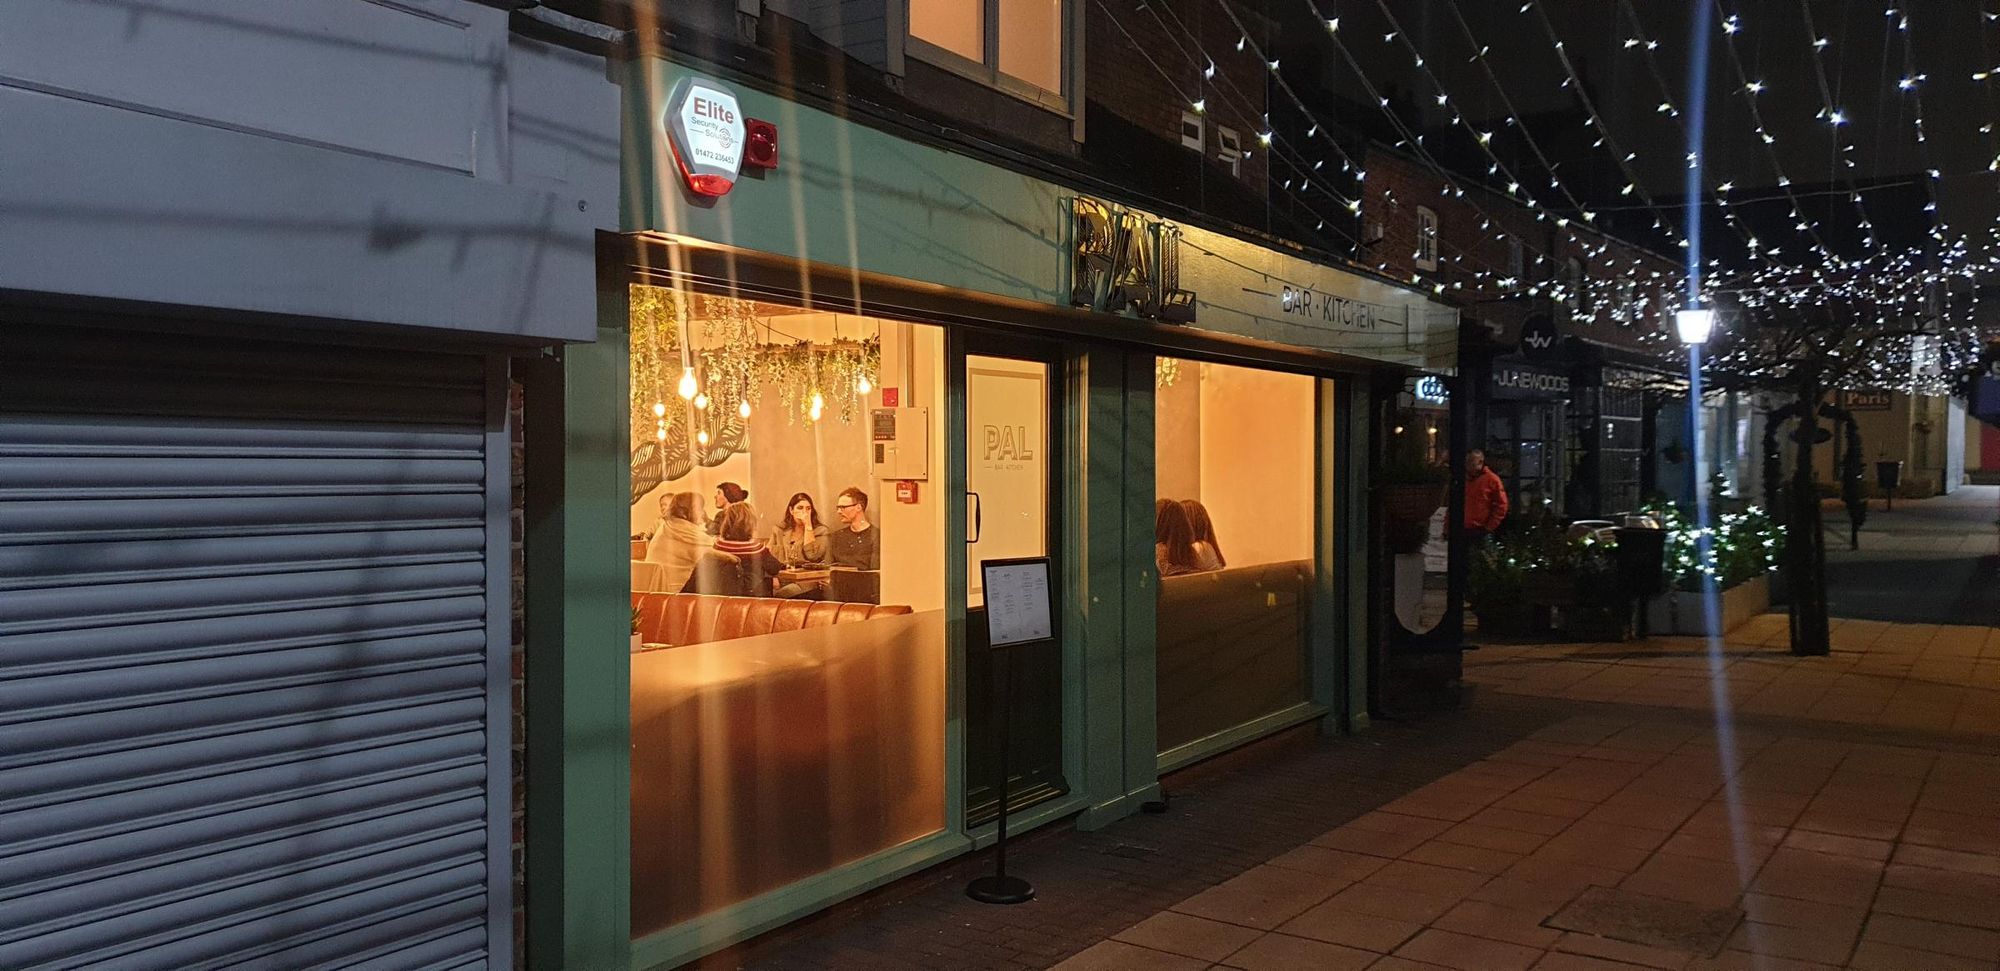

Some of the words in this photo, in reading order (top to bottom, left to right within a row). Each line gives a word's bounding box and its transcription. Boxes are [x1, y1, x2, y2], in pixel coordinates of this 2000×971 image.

[691, 116, 719, 130] Security
[694, 97, 733, 124] Elite
[695, 148, 714, 159] 01472
[1072, 194, 1197, 323] PAL
[1283, 285, 1312, 318] BAR
[1323, 295, 1375, 330] KITCHEN
[1847, 391, 1889, 405] Paris
[983, 424, 1034, 461] PAL
